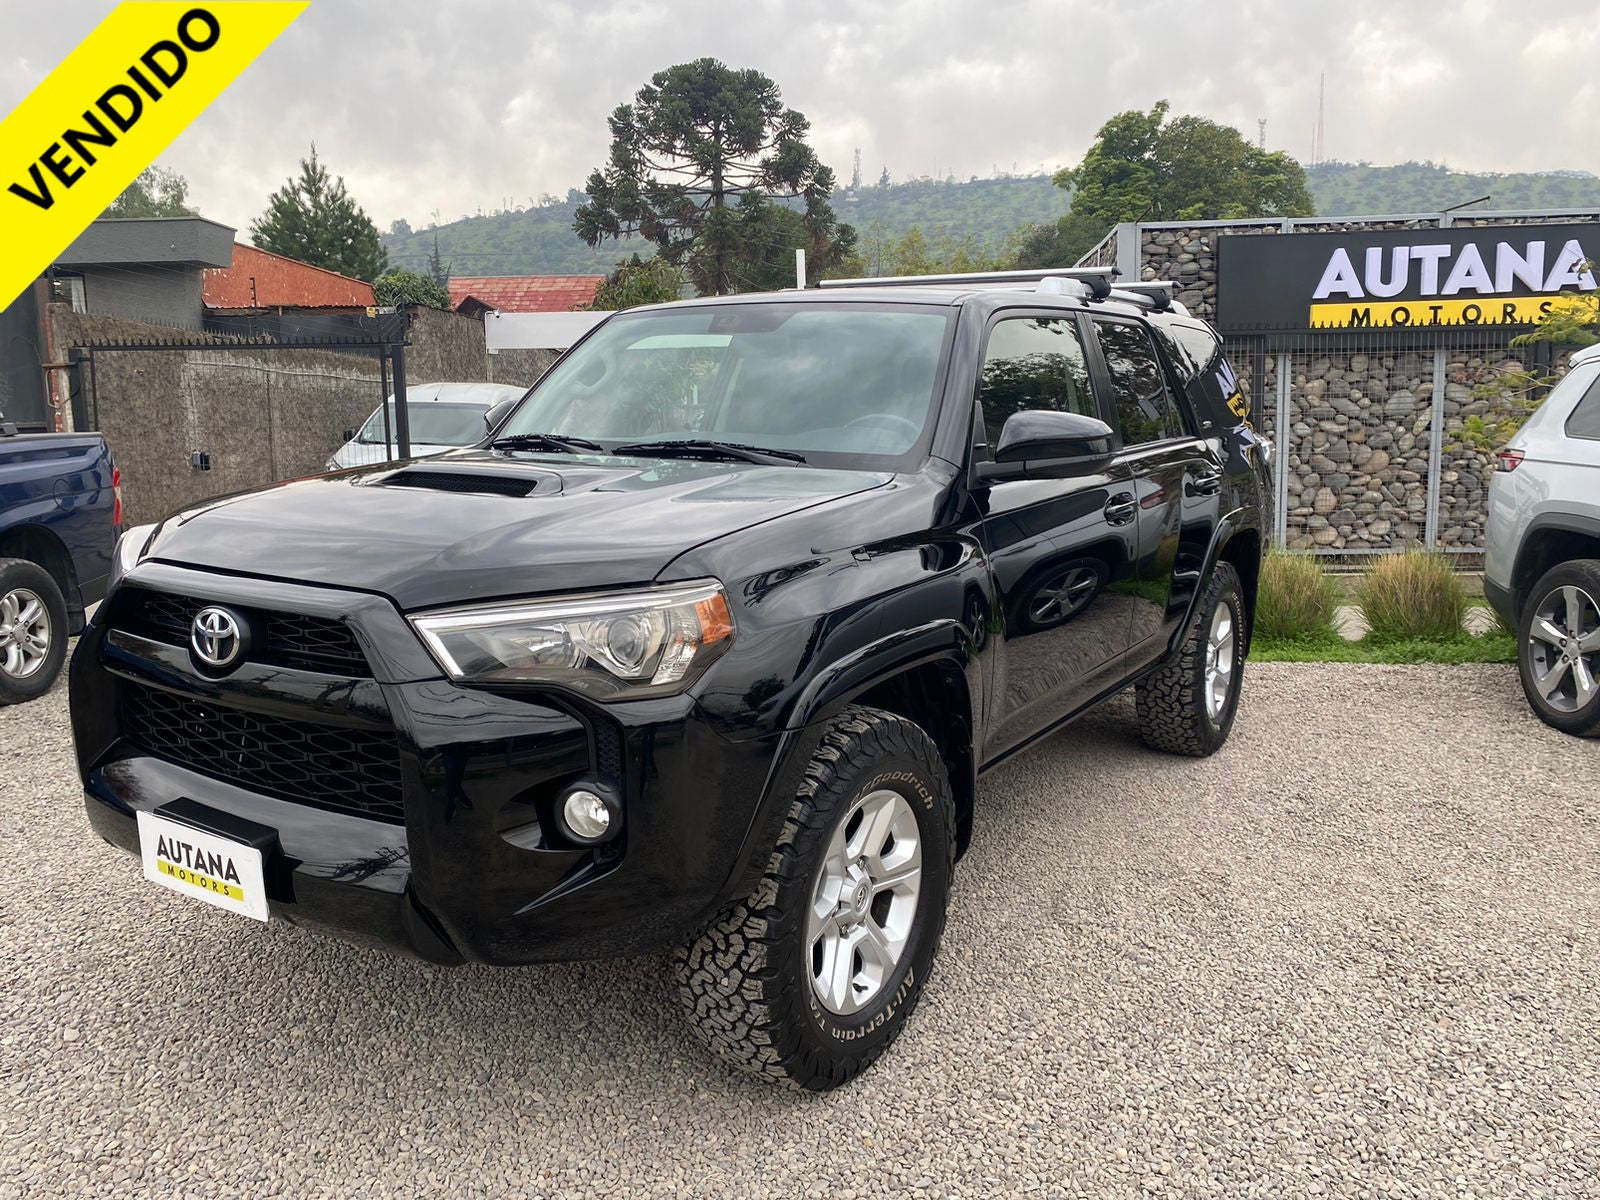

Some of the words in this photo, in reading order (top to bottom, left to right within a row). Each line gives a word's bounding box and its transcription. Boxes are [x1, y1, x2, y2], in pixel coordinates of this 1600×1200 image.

[1312, 239, 1599, 299] AUTANA
[1350, 301, 1553, 326] MOTORS
[157, 834, 241, 885] AUTANA
[167, 865, 229, 896] MOTORS
